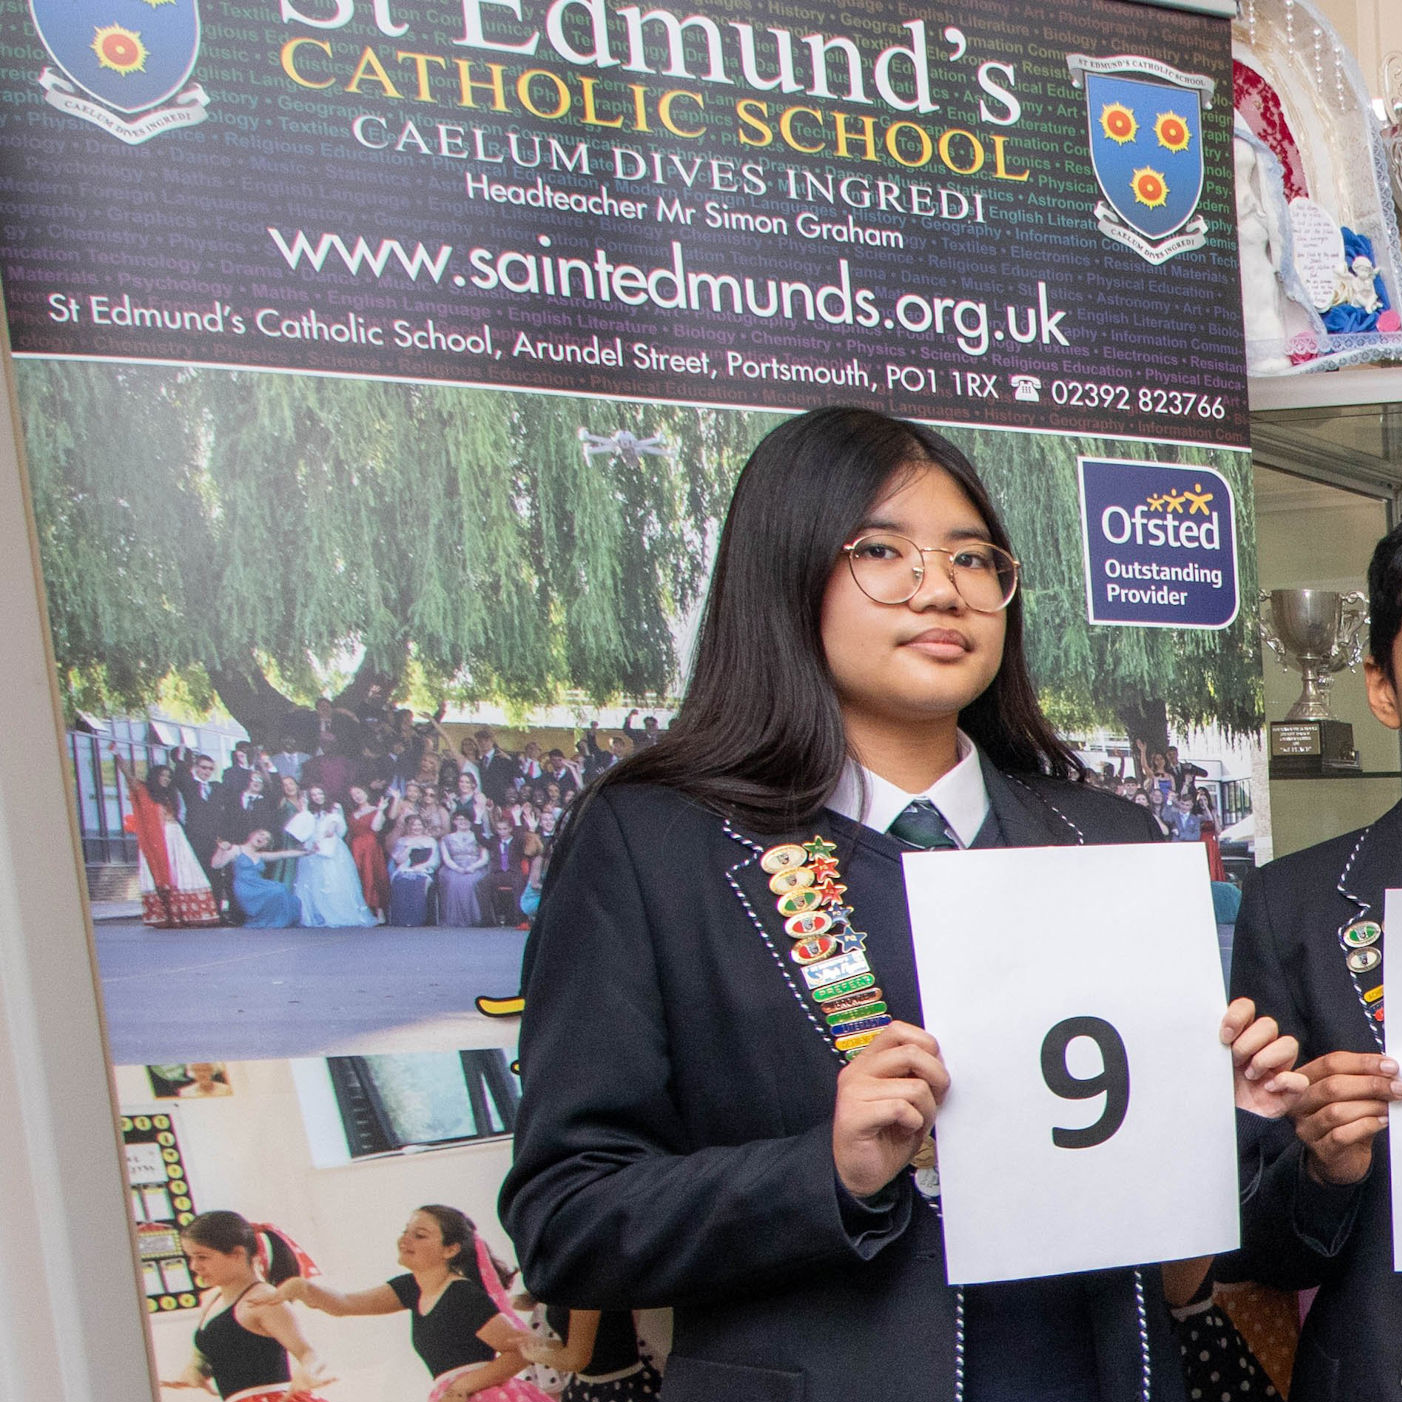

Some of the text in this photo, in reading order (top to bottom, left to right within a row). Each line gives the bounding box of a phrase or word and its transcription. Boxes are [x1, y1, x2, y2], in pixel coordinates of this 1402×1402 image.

[280, 36, 1028, 180] CATHOLIC SCHOOL
[352, 111, 985, 223] CAELUM DIVES INGREDI
[465, 171, 904, 249] Headteacher Mr Simon Graham
[267, 227, 1070, 356] www.saintedmunds.org.uk
[48, 293, 1225, 420] St Edmund's Catholic School, Arundel Street, Portsmouth, PO1 1RX 02392 823766
[1101, 505, 1221, 550] Ofsted
[1104, 559, 1222, 589] Outstanding
[1106, 584, 1188, 606] Provider
[1040, 1016, 1130, 1149] 9
